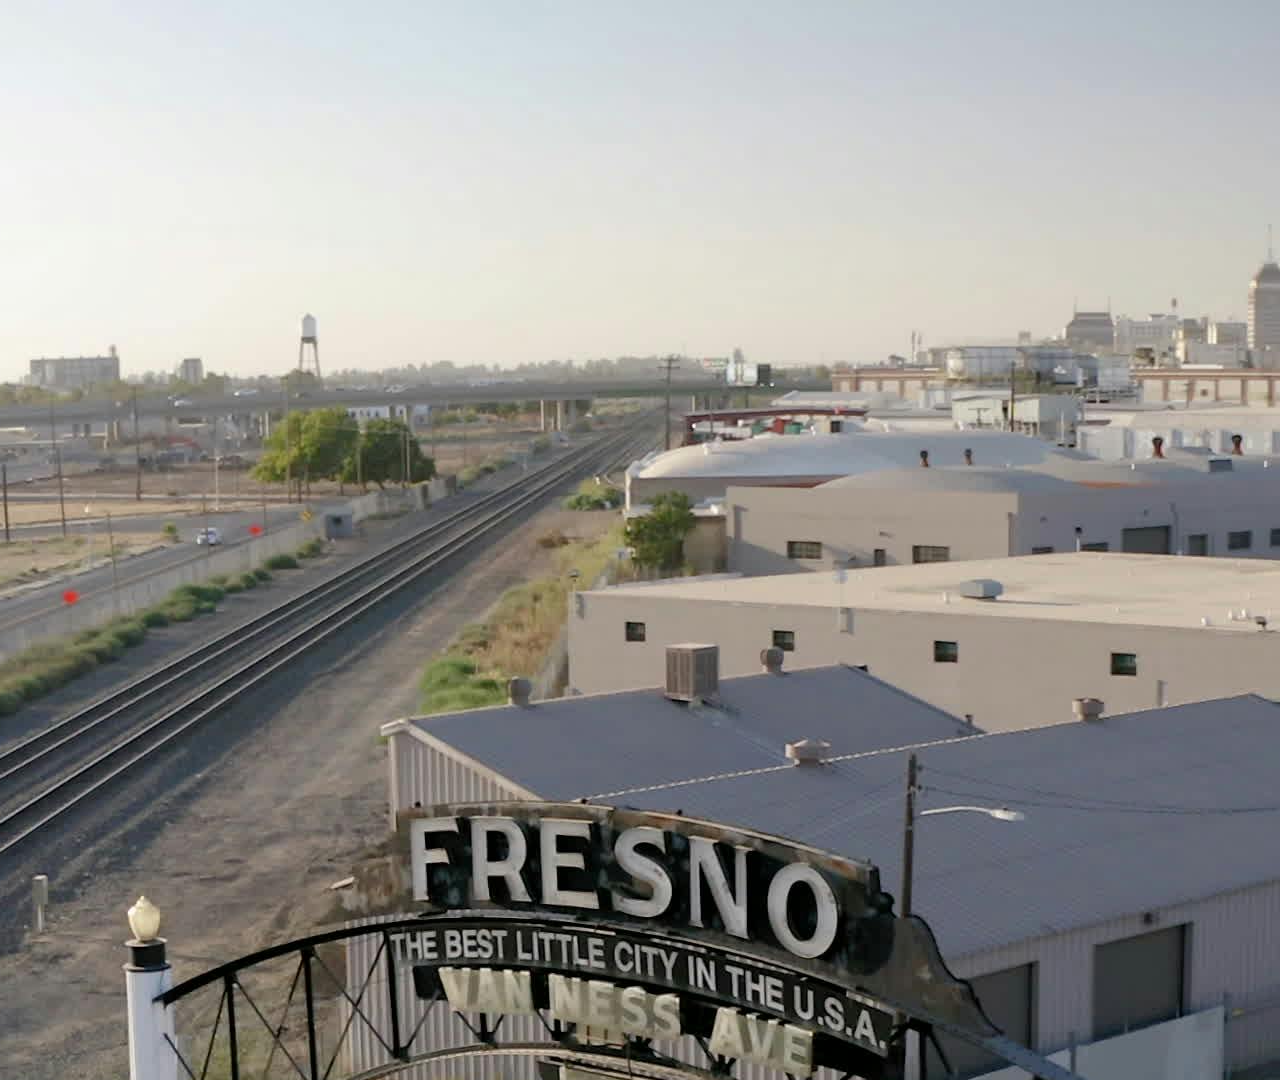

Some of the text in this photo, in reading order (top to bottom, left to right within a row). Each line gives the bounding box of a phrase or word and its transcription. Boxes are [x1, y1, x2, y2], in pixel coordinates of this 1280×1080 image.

[409, 816, 838, 958] FRESNO
[390, 929, 886, 1049] THE BEST LITTLE CITY IN THE U.S.A.
[438, 966, 813, 1078] VAN NESS AVE
